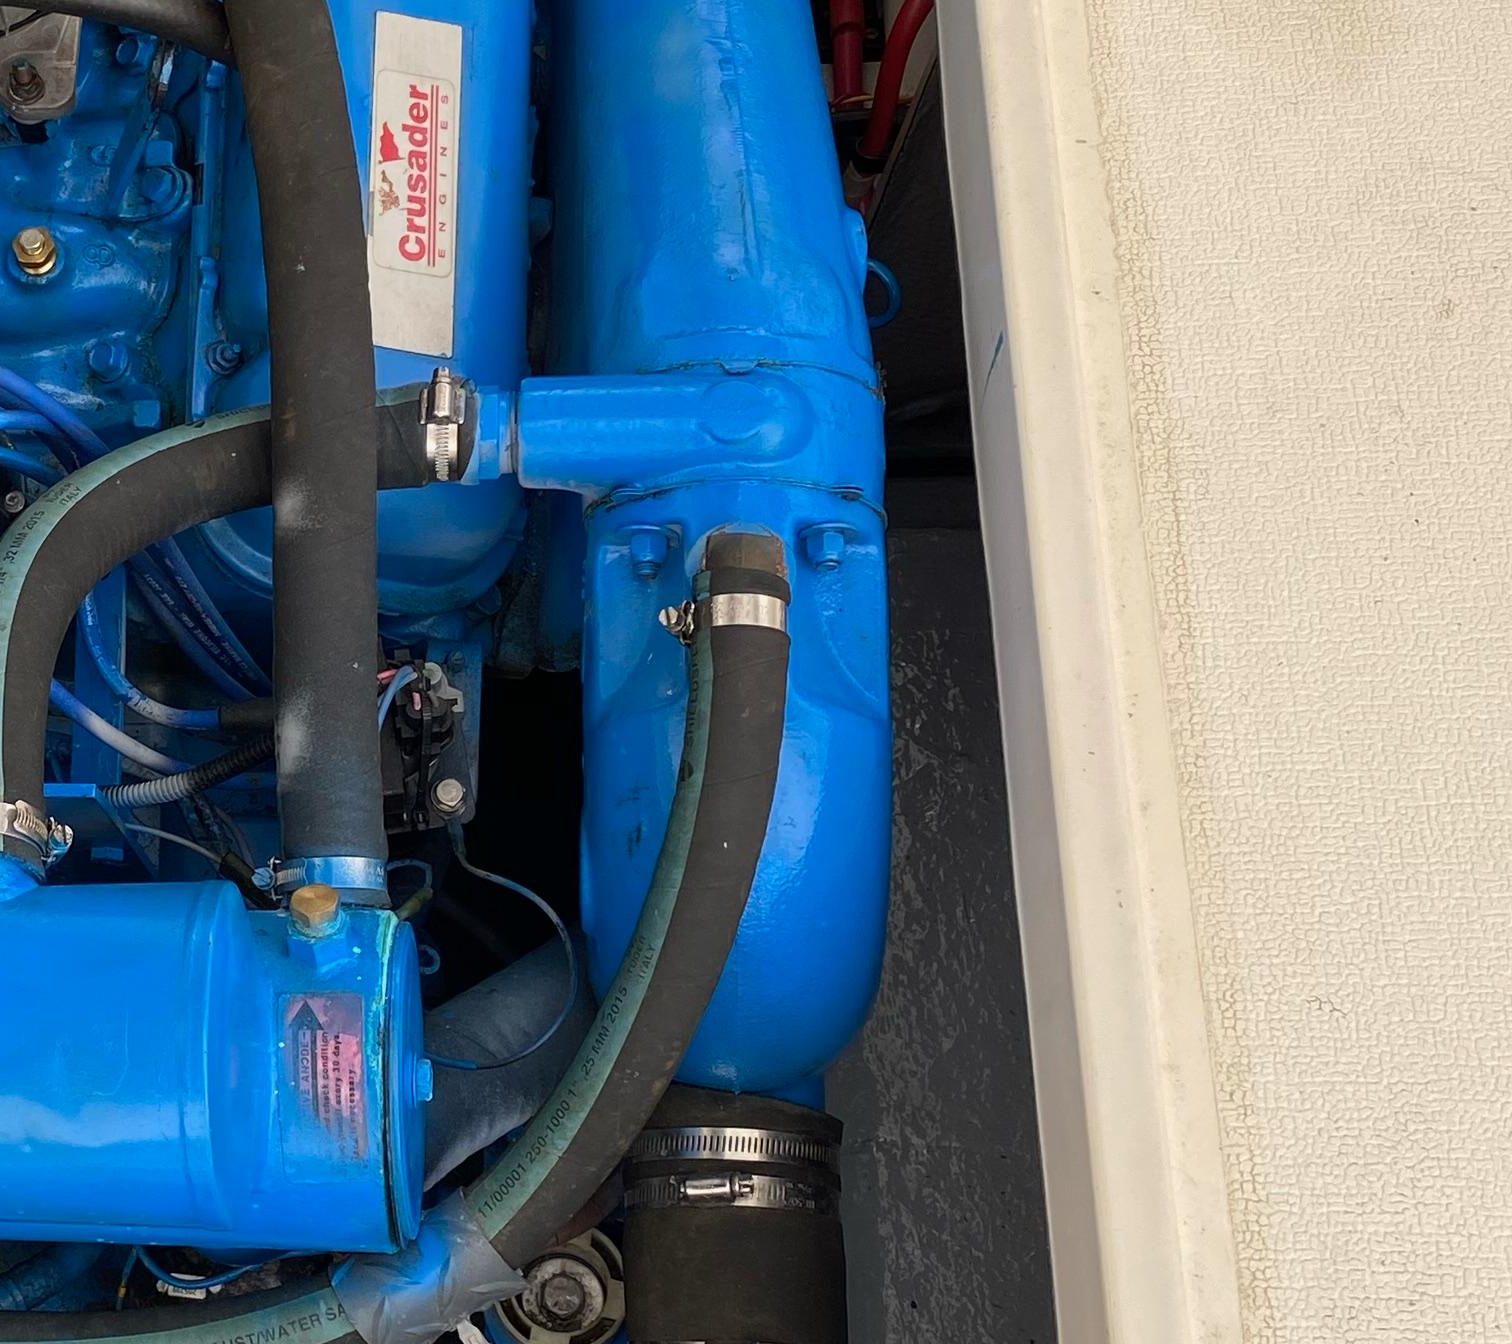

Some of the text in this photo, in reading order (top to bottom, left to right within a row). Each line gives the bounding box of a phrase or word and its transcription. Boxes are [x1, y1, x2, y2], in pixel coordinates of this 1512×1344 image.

[398, 84, 430, 262] Crusader
[438, 94, 449, 259] ENGINES
[58, 486, 82, 507] ITALY
[12, 530, 28, 549] MM
[22, 509, 46, 531] 2015
[321, 1031, 329, 1079] condition
[477, 1161, 528, 1219] 11/00001
[524, 1098, 571, 1163] 250-1000
[593, 1025, 611, 1055] MM
[606, 985, 628, 1025] 2015
[325, 1302, 346, 1322] SA
